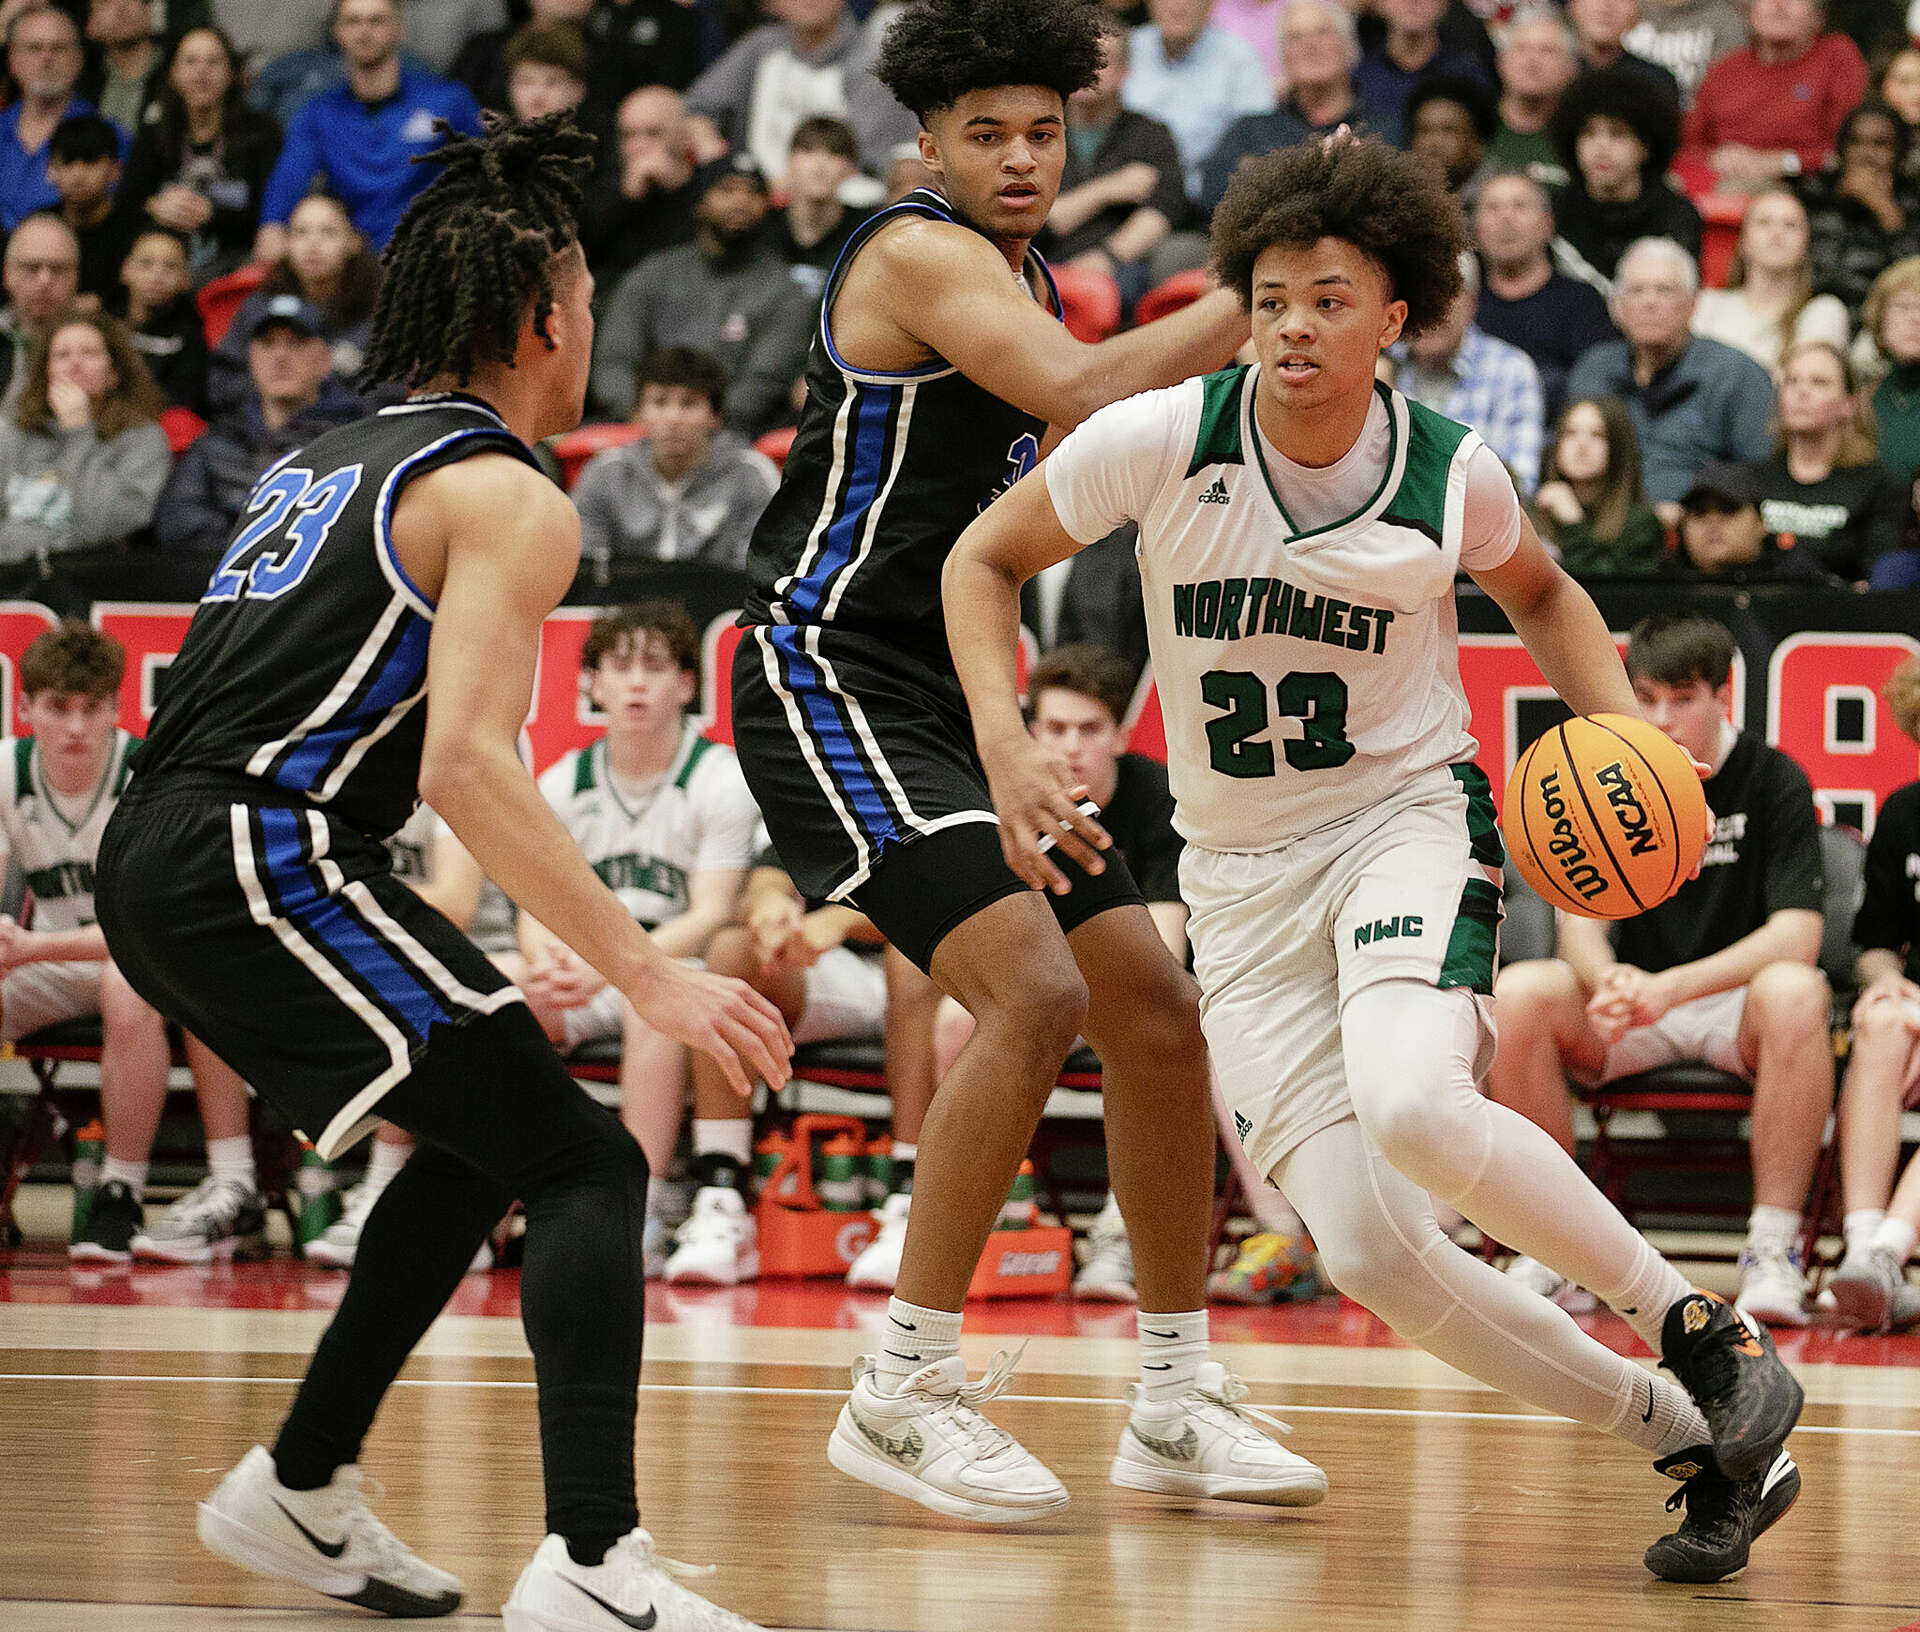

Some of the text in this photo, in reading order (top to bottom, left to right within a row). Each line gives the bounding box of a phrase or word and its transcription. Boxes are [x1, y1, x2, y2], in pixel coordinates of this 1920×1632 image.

[199, 462, 365, 602] 23
[1173, 577, 1395, 655] NORTHWEST
[1199, 670, 1357, 779] 23
[1539, 770, 1609, 901] Wilson
[1596, 761, 1659, 857] NCAA
[1354, 915, 1424, 952] NWC
